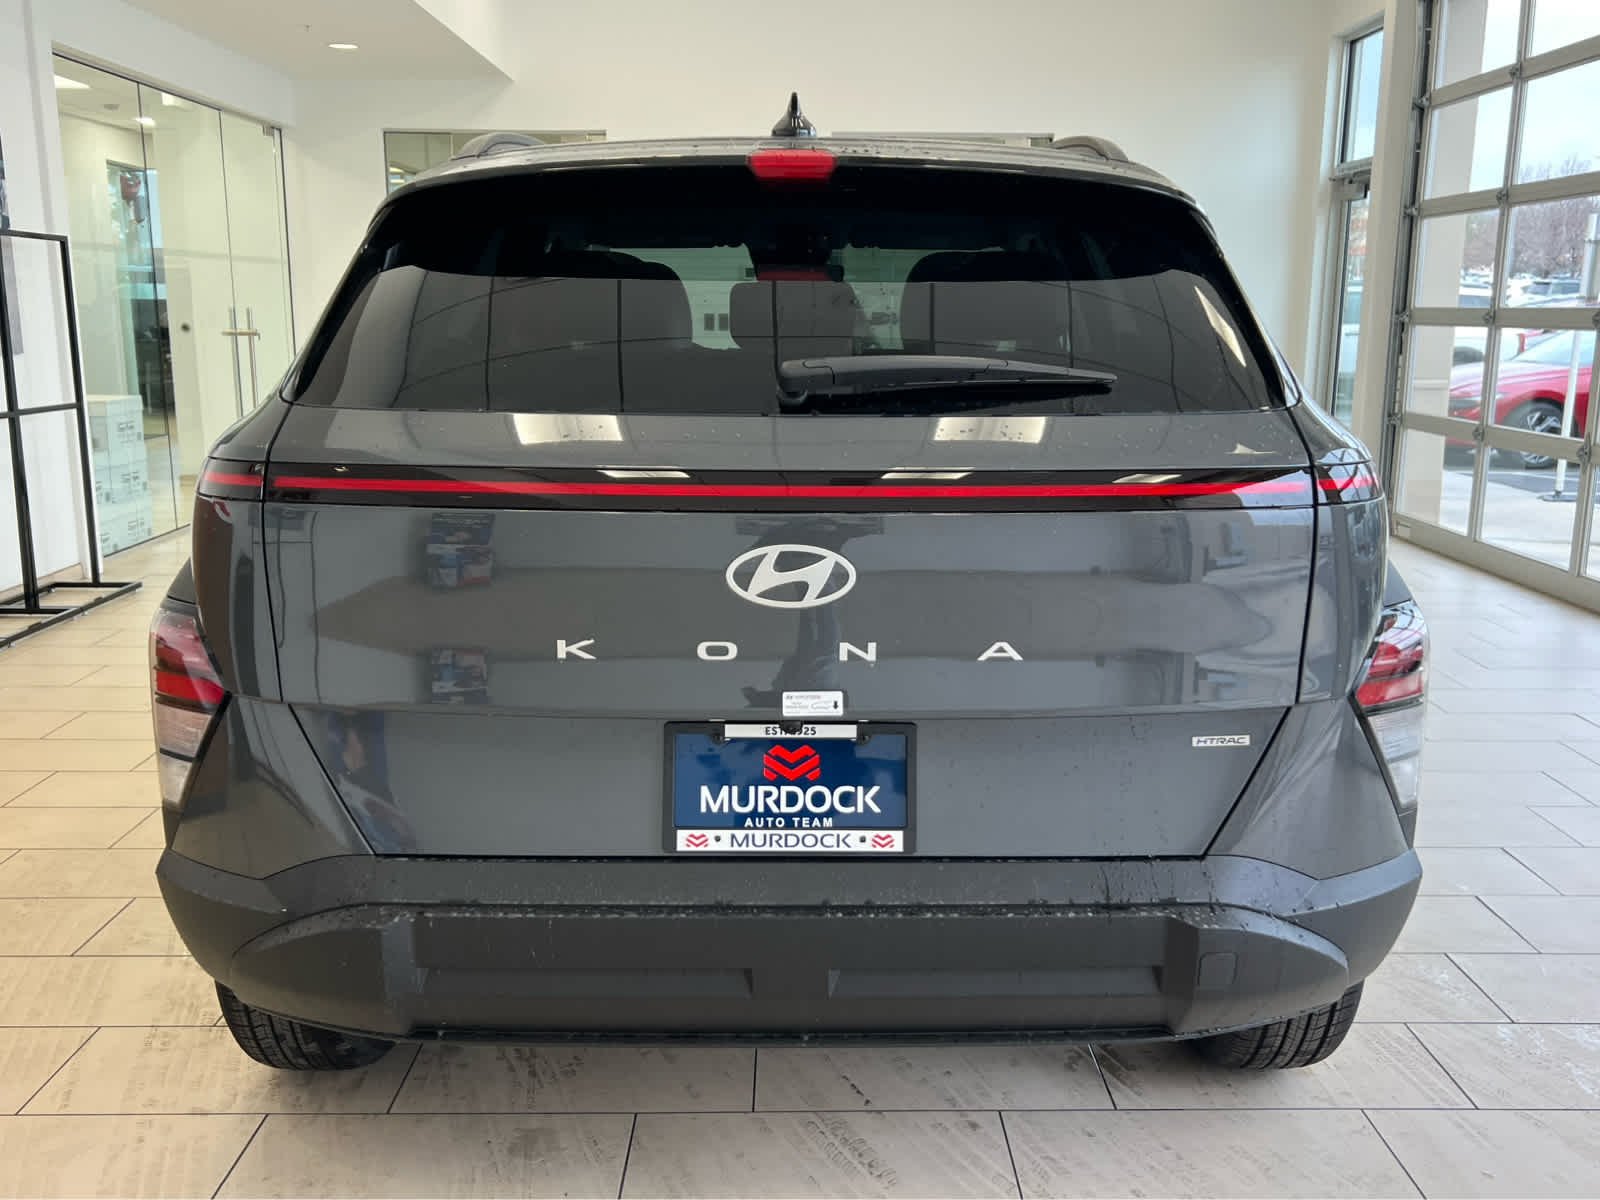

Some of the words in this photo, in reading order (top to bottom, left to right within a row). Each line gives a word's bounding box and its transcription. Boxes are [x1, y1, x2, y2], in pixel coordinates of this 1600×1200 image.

[556, 639, 1024, 661] KONA
[1196, 737, 1248, 745] HTRAC
[700, 785, 881, 813] MURDOCK
[744, 817, 785, 828] AUTO
[792, 817, 833, 828] TEAM
[730, 833, 851, 848] MURDOCK
